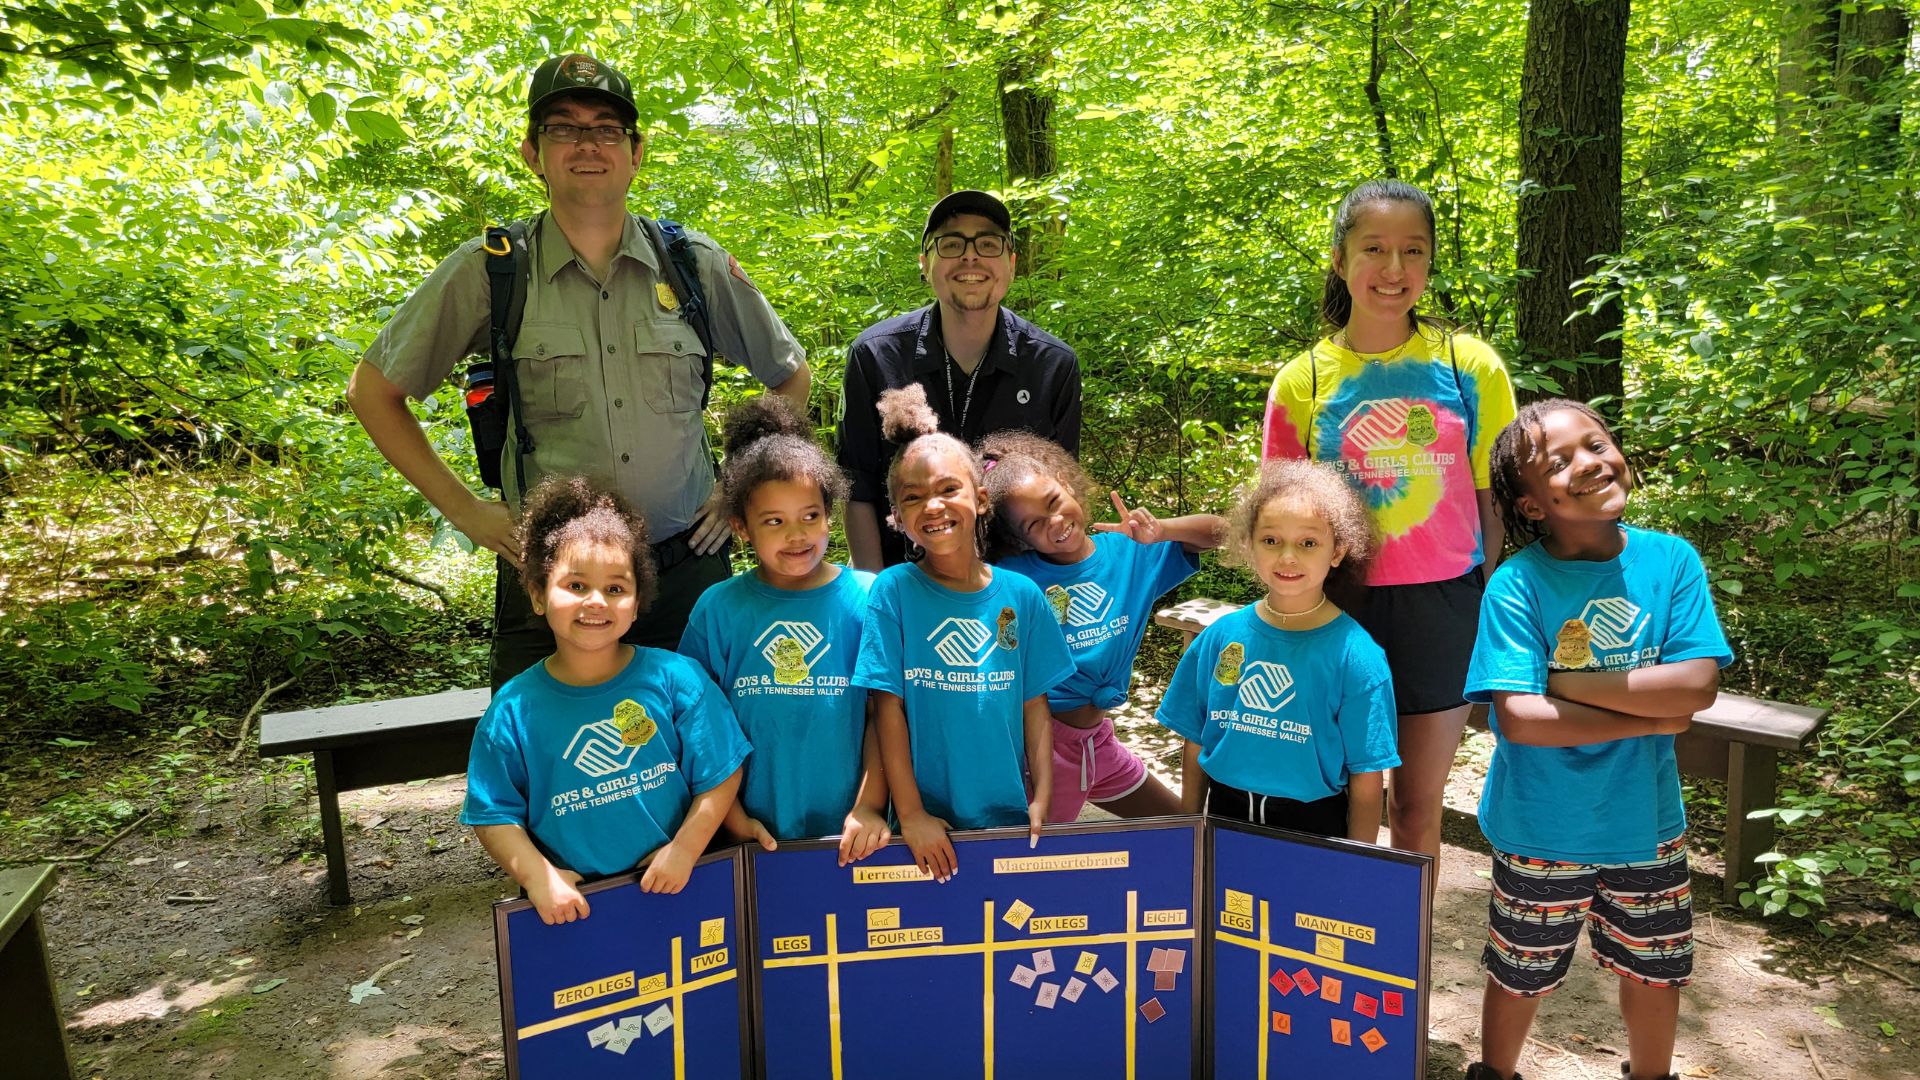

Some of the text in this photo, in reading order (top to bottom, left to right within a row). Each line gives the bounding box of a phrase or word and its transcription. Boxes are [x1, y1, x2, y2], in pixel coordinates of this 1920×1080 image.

[1348, 459, 1360, 470] &
[1363, 454, 1408, 469] GIRLS
[1412, 452, 1456, 465] CLUBS
[1352, 469, 1410, 480] TENNESSEE
[1412, 466, 1447, 476] VALLEY
[1066, 633, 1076, 643] &
[1077, 624, 1109, 640] GIRLS
[1071, 631, 1113, 650] TENNESSEE
[1604, 650, 1639, 666] GIRLS
[760, 674, 772, 685] &
[934, 669, 945, 681] &
[947, 671, 985, 683] GIRLS
[988, 671, 1015, 682] CLUBS
[747, 687, 762, 695] THE
[763, 687, 815, 696] TENNESSEE
[817, 688, 845, 696] VALLEY
[921, 680, 936, 689] THE
[938, 682, 987, 692] TENNESSEE
[988, 682, 1010, 691] VALLEY
[1231, 721, 1277, 739] TENNESSEE
[1279, 731, 1308, 744] VALLEY
[1242, 713, 1278, 728] GIRLS
[1280, 720, 1312, 736] CLUB
[582, 787, 596, 798] &
[596, 773, 638, 794] GIRLS
[640, 762, 676, 782] CLUBS
[555, 775, 667, 817] OF THE TENNESSEE VALLEY
[997, 855, 1127, 871] Macroinvertebrates
[1032, 917, 1086, 931] SIX LEGS
[1146, 912, 1184, 923] EIGHT
[1223, 914, 1251, 930] LEGS
[1297, 915, 1372, 941] MANY LEGS
[776, 938, 808, 951] LEGS
[870, 929, 941, 945] FOUR LEGS
[693, 951, 726, 969] TWO
[557, 976, 632, 1005] ZERO LEGS
